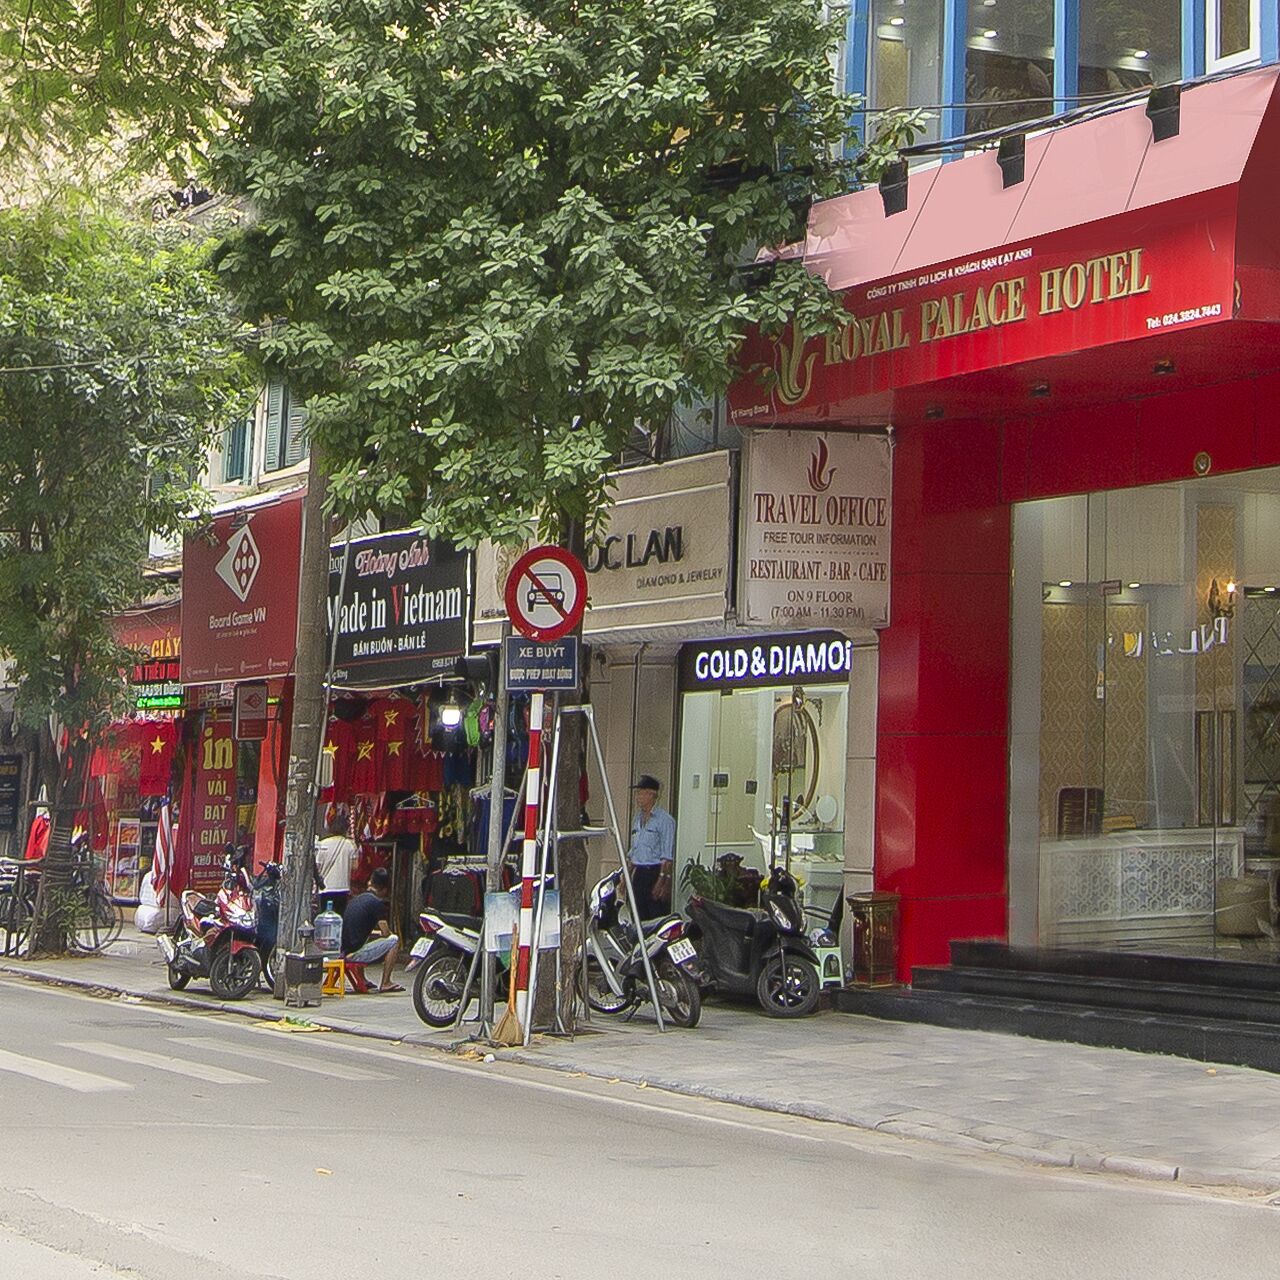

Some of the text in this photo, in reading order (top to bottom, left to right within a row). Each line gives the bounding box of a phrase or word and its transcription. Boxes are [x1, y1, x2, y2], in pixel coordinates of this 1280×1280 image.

[824, 246, 1153, 366] ROYAL PALACE HOTEL
[753, 493, 888, 527] TRAVEL OFFICE
[625, 525, 683, 569] LAN
[763, 531, 877, 546] FREE TOUR INFORMATION
[329, 551, 345, 574] hop
[355, 548, 398, 578] Hoàng
[750, 559, 887, 582] RESTAURANT BAR CAFE
[636, 573, 676, 589] DIAMOND
[686, 567, 723, 584] JEWELRY
[327, 582, 462, 635] Made in Vietnam
[787, 590, 854, 603] ON 9 FLOOR
[208, 606, 267, 631] Board Game VN
[353, 639, 370, 657] BÁN
[518, 643, 565, 658] XE BUÝT
[695, 648, 749, 680] GOLD
[202, 727, 234, 770] in
[207, 774, 228, 797] VẢI
[200, 823, 228, 846] GIẤY
